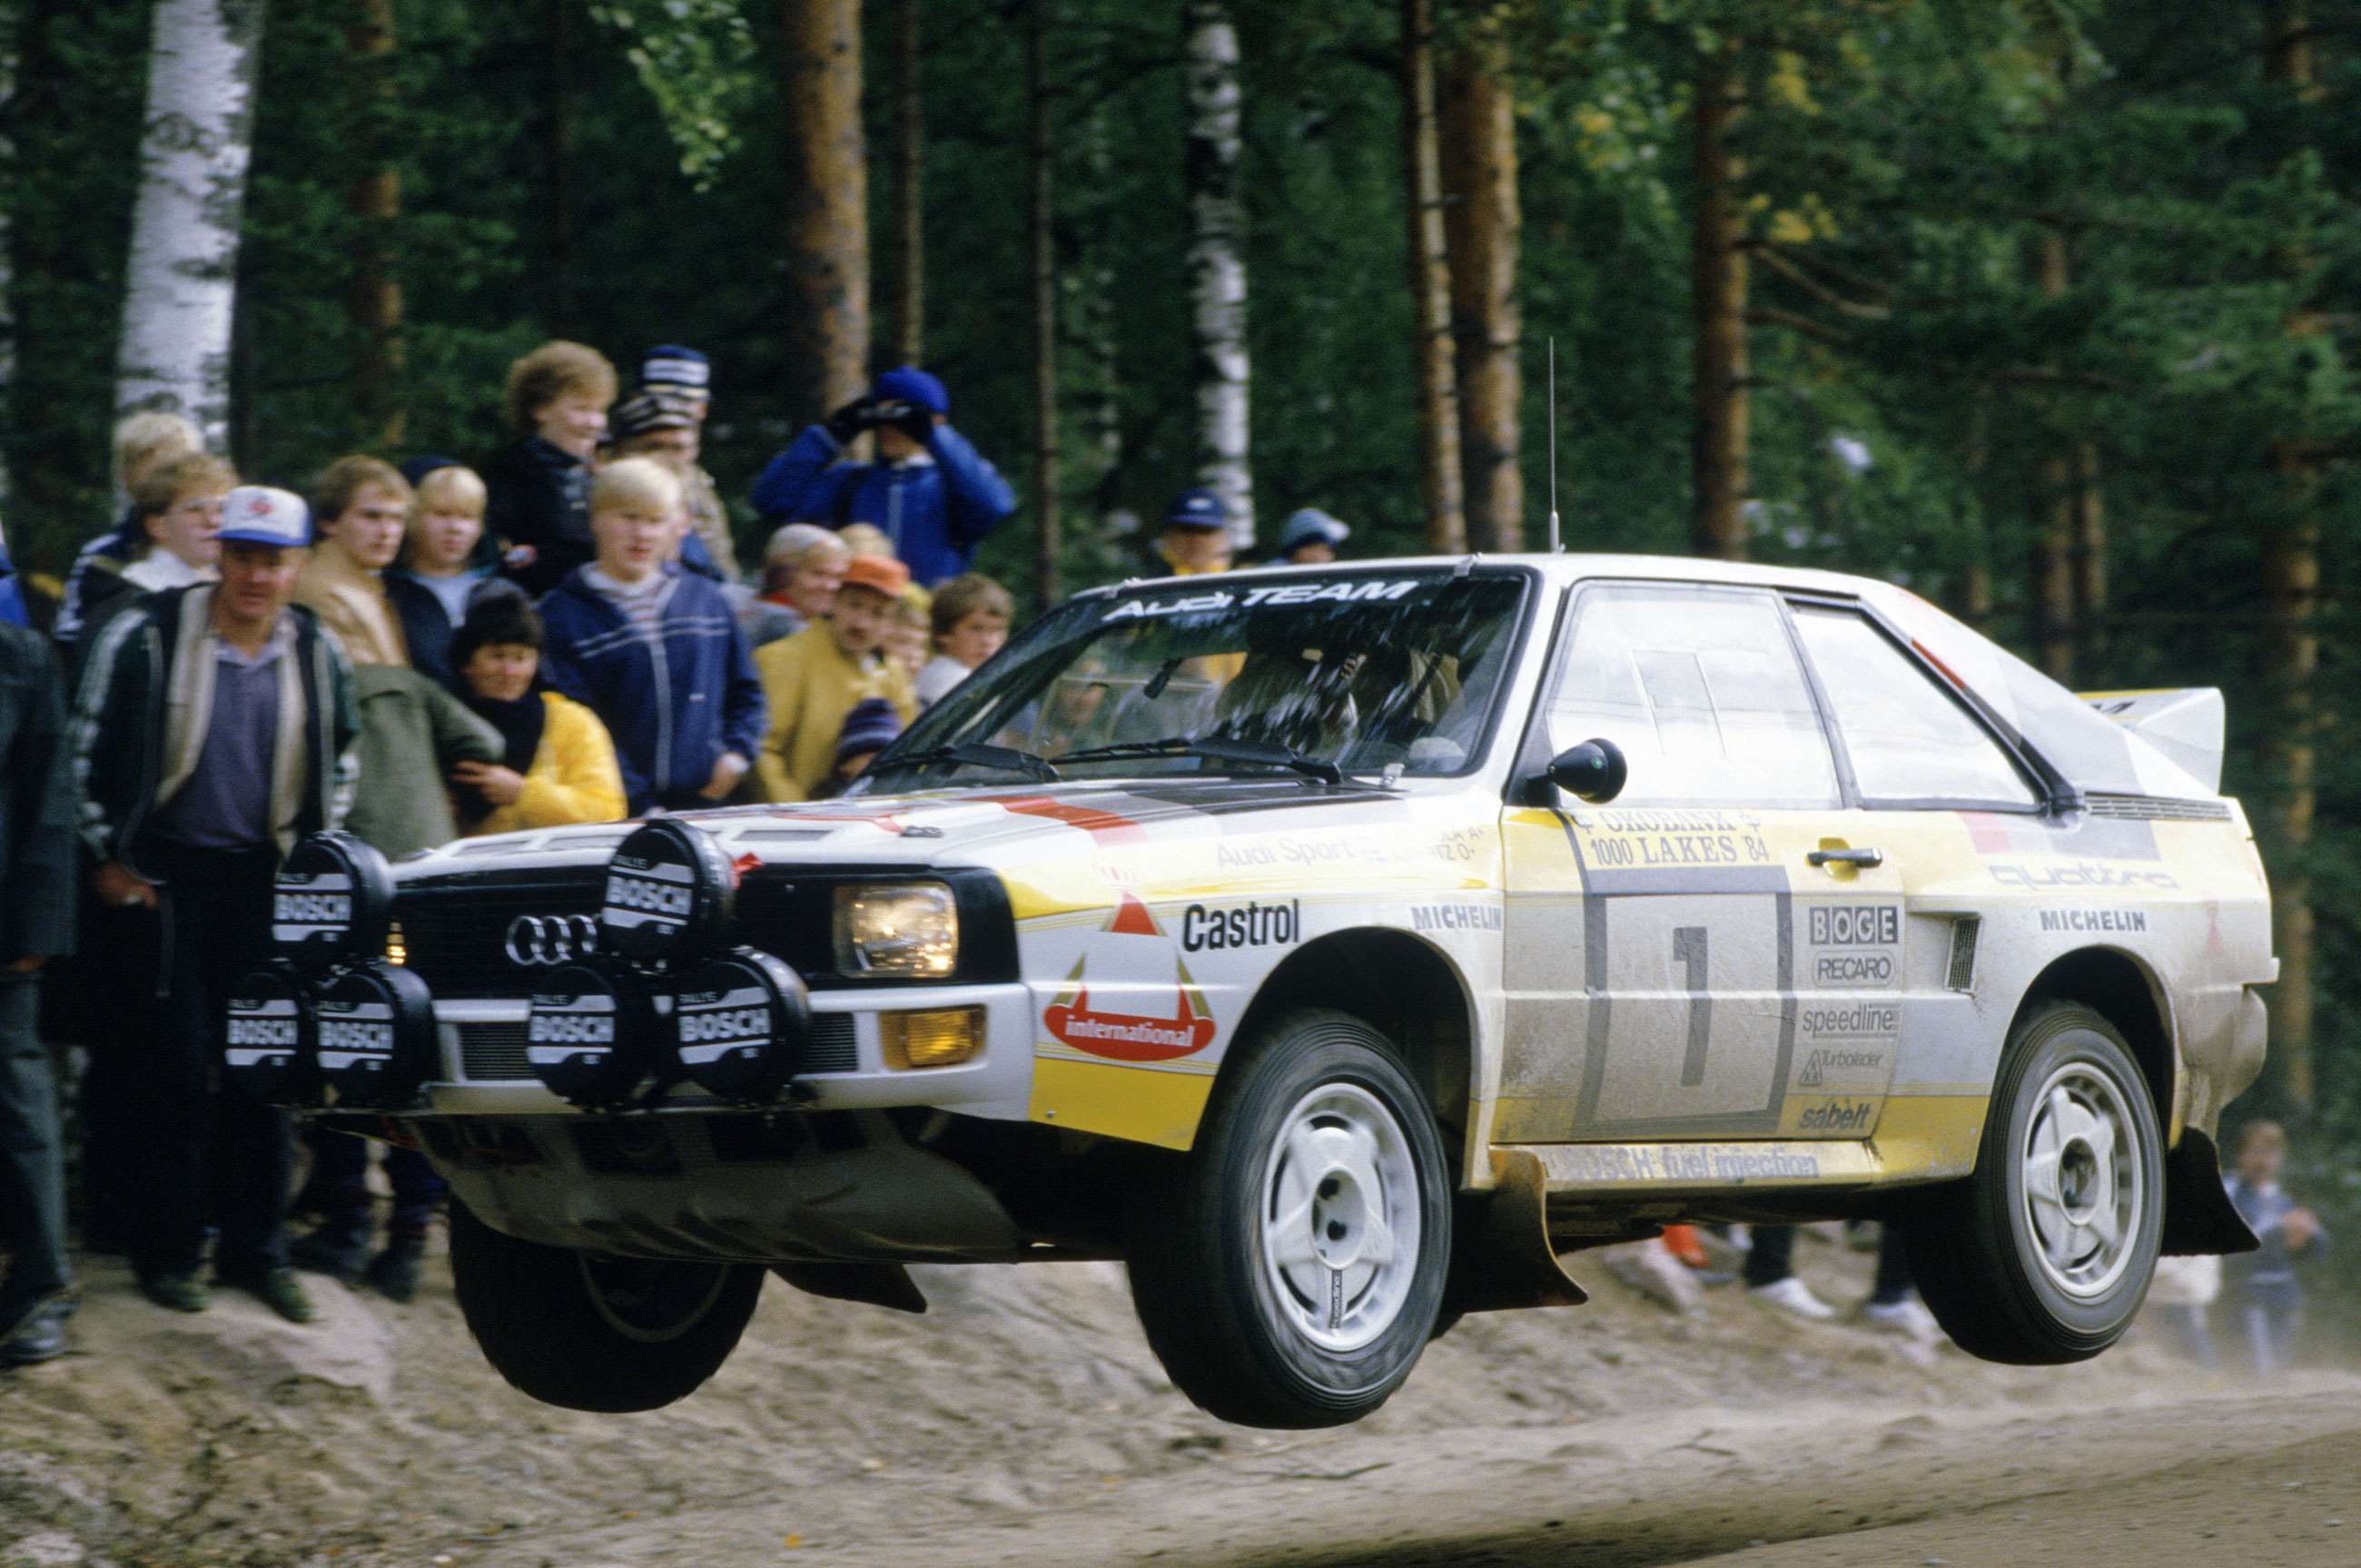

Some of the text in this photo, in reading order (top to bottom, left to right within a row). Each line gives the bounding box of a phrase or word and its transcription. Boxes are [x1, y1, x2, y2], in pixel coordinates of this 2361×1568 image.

[1241, 581, 1421, 606] TEAM
[1217, 840, 1277, 868] Audi
[1279, 835, 1354, 867] Sport
[1591, 835, 1770, 865] 1000 LAKES '84
[1989, 862, 2181, 891] quattro
[274, 893, 351, 921] BOSCH
[606, 876, 692, 915] BOSCH
[1183, 899, 1299, 952] Castrol
[1411, 904, 1502, 931] MICHELIN
[1812, 909, 1895, 942] BOGE
[2039, 909, 2148, 932] MICHELIN
[1817, 957, 1892, 981] RECARO
[1673, 925, 1713, 1088] 1
[1803, 1003, 1893, 1039] speedline
[226, 1019, 299, 1045] BOSCH
[318, 1021, 394, 1049] BOSCH
[529, 1016, 615, 1041] BOSCH
[678, 1008, 770, 1042] BOSCH
[1064, 1013, 1195, 1048] international
[1798, 1100, 1871, 1129] sabelt
[1659, 1143, 1709, 1178] fuel
